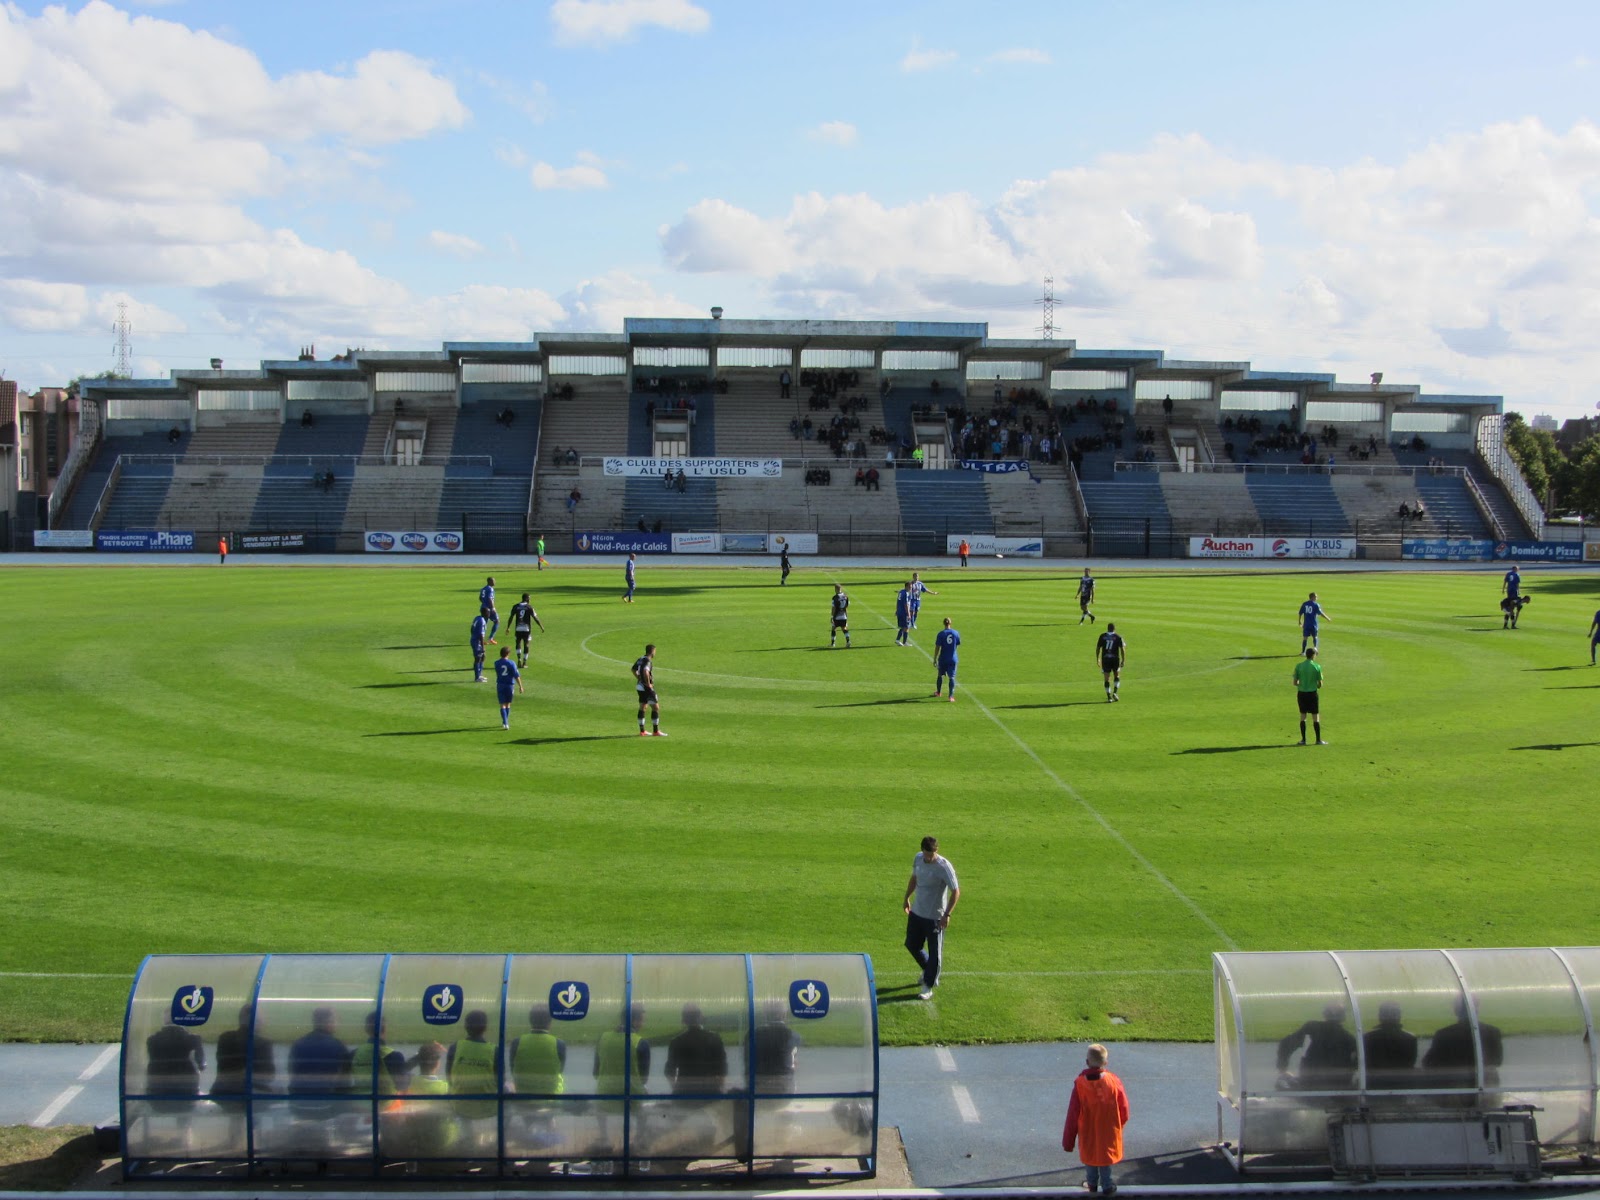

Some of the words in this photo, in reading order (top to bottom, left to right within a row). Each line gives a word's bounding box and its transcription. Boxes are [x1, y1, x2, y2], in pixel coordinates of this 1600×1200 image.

[627, 459, 657, 467] CLUB
[685, 460, 759, 468] SUPPORTERS
[961, 461, 1029, 472] ULTRAS
[149, 538, 157, 546] Le
[157, 531, 193, 546] Phare
[370, 534, 392, 543] Delta
[403, 534, 425, 543] Delta
[436, 534, 458, 543] Delta
[592, 542, 630, 551] Nord-Pas
[631, 542, 641, 551] de
[642, 542, 668, 551] Calais
[1201, 537, 1254, 551] Auchan
[1305, 539, 1342, 549] DK'BUS
[1511, 545, 1553, 556] Domino's
[1555, 546, 1580, 556] Pizza
[519, 609, 525, 619] 9
[1305, 605, 1313, 614] 10
[946, 634, 953, 644] 6
[501, 664, 509, 676] 2
